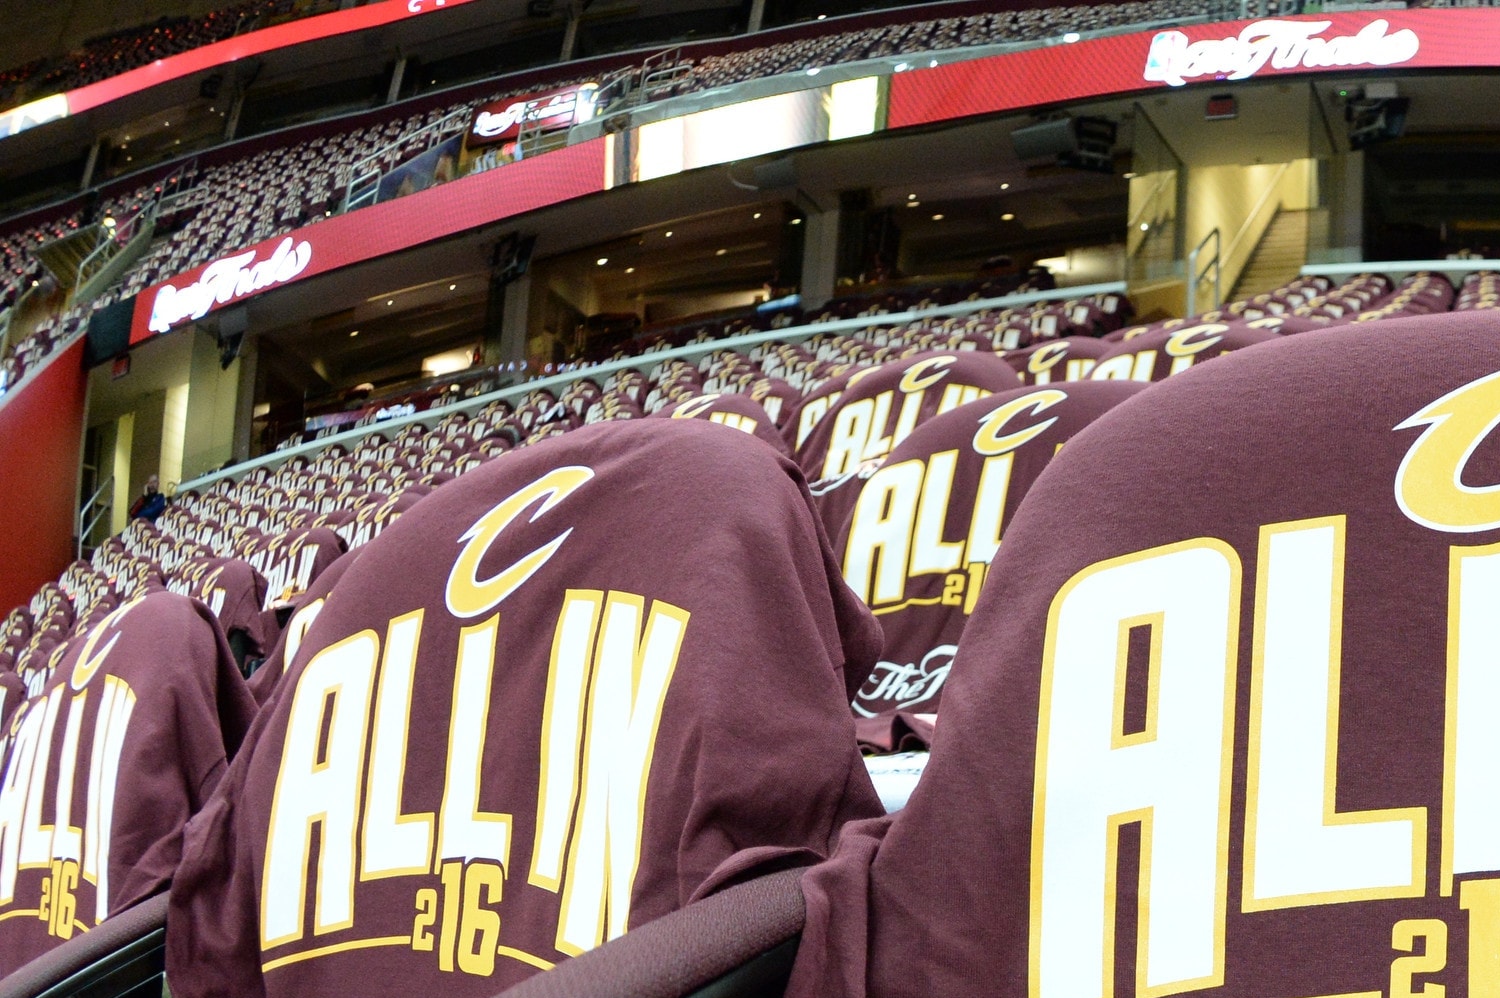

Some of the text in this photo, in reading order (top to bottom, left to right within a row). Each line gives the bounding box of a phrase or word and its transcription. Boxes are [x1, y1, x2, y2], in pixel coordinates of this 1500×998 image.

[261, 588, 691, 957] ALL IN
[413, 863, 503, 977] 216
